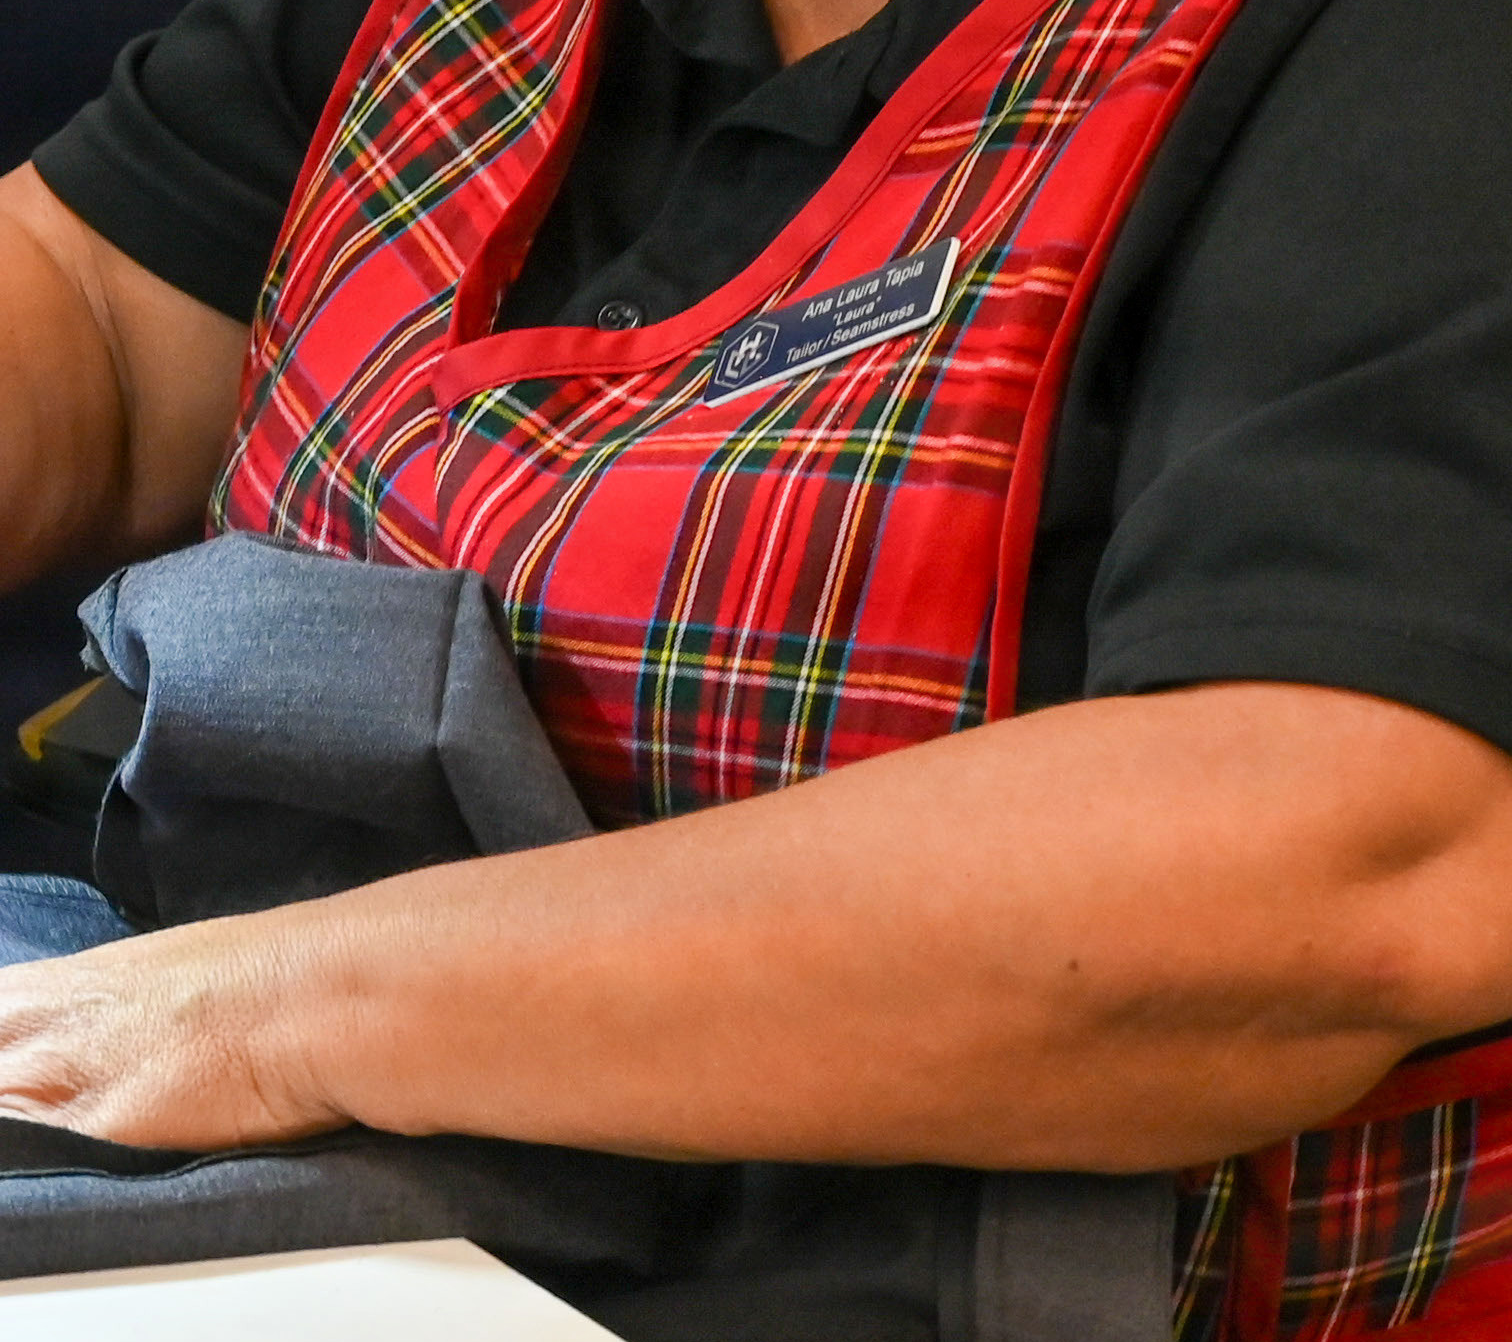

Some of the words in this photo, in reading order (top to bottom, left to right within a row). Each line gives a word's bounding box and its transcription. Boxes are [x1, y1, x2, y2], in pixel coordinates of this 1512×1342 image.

[802, 297, 833, 322] Ana
[836, 276, 879, 308] Laura
[885, 261, 925, 288] Tapia
